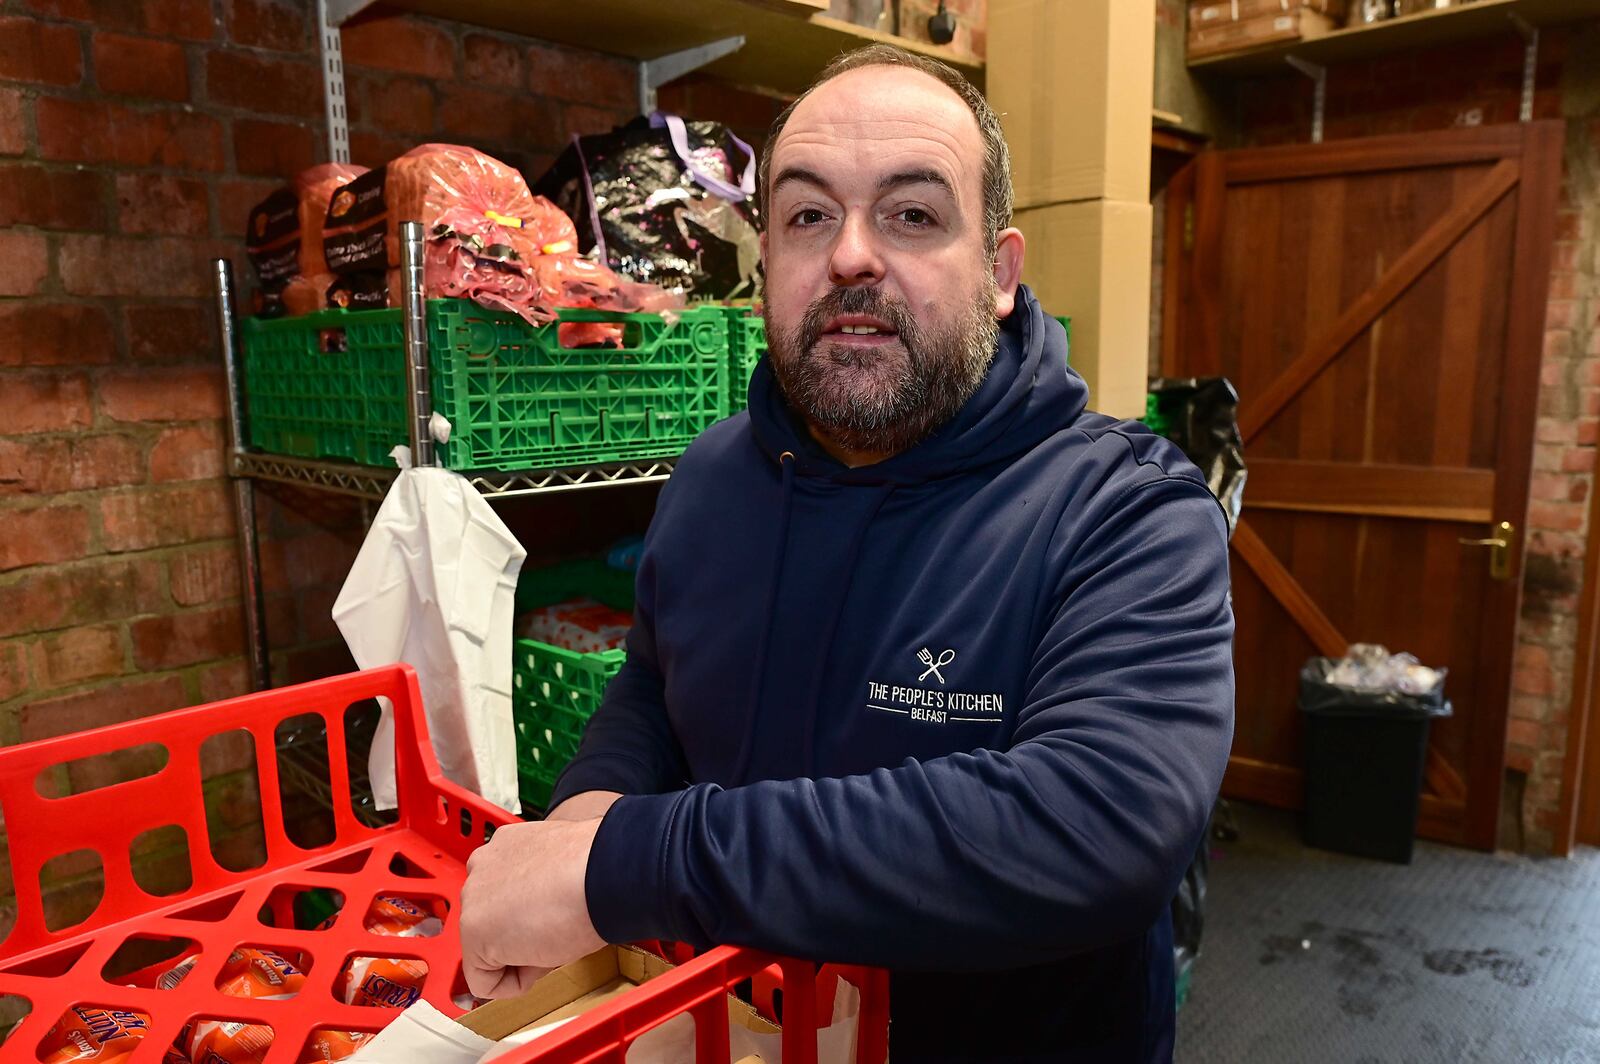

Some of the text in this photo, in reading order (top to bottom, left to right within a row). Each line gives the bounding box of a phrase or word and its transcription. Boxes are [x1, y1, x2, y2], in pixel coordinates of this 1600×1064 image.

[868, 681, 1003, 712] THE PEOPLE'S KITCHEN
[911, 708, 947, 723] BELFAST
[72, 1007, 130, 1043] NUTT
